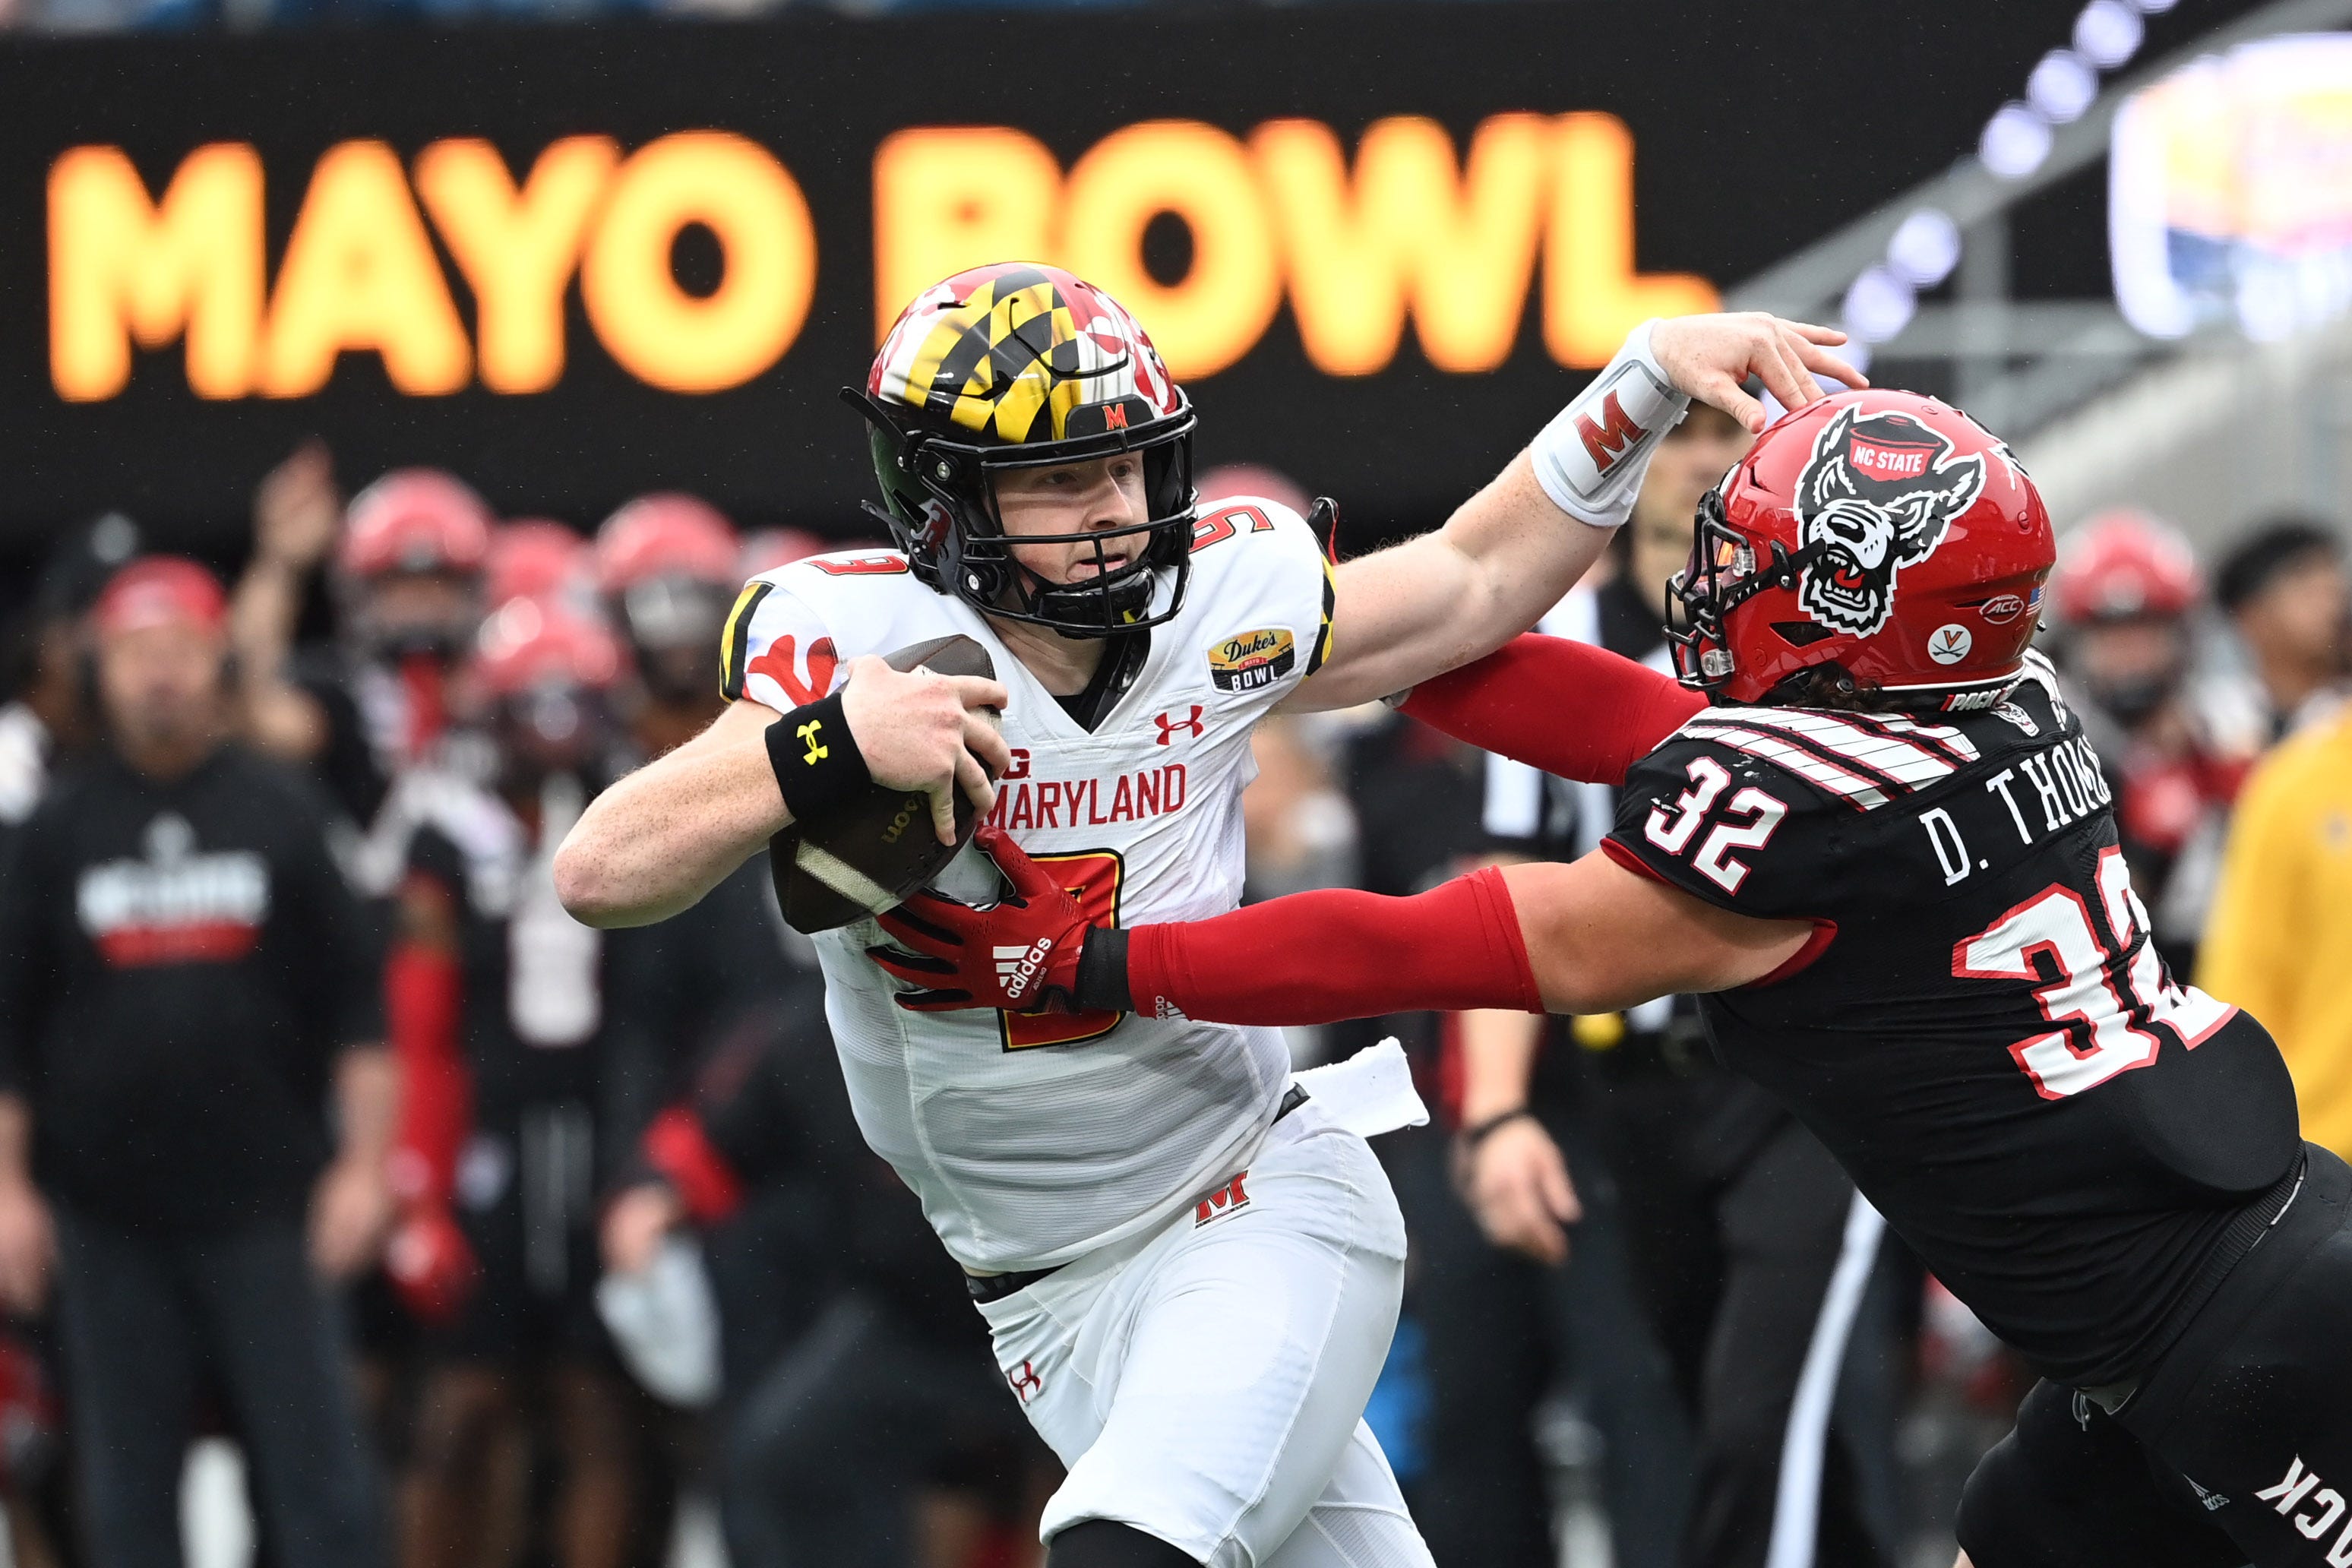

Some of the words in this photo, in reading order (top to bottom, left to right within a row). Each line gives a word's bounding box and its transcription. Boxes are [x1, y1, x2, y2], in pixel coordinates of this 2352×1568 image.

[47, 130, 817, 401] MAYO
[873, 110, 1721, 380] BOWL
[1102, 403, 1128, 430] M
[1573, 389, 1650, 473] M
[1853, 445, 1876, 466] NC
[1876, 451, 1924, 473] STATE
[1986, 599, 2021, 615] ACC
[1223, 631, 1278, 663] Duke's
[1943, 630, 1964, 650] V
[1231, 665, 1279, 693] BOWL
[978, 763, 1187, 830] MARYLAND
[1643, 755, 1789, 897] 32
[1918, 807, 1989, 887] D.
[1985, 734, 2112, 845] THOM
[1007, 937, 1052, 999] adidas
[1950, 843, 2240, 1101] 32
